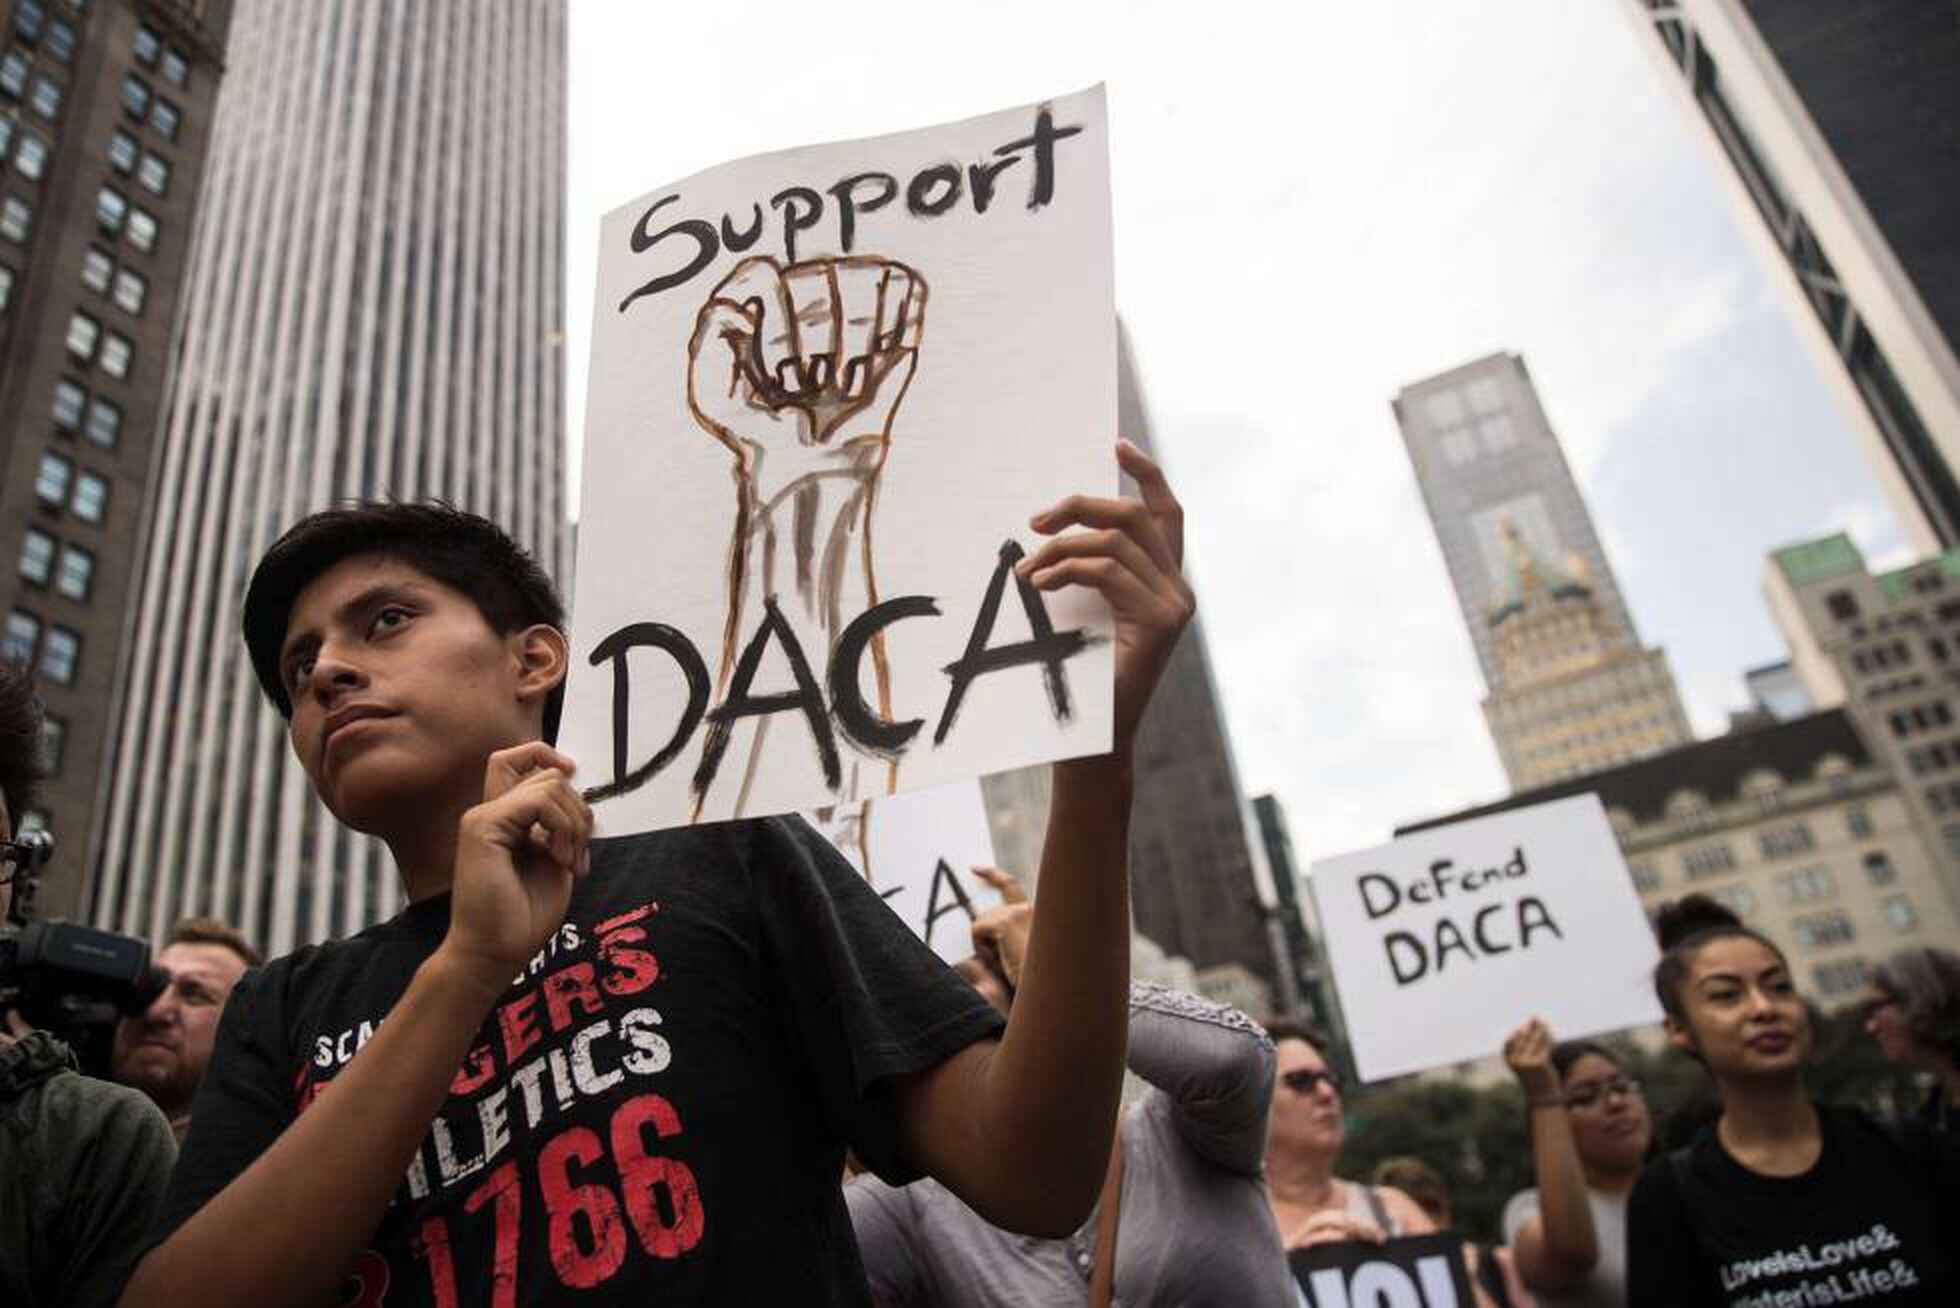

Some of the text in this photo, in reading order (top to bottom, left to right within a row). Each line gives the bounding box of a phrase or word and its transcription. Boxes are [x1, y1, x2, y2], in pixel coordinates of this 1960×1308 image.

[618, 101, 1083, 313] Support
[583, 538, 1104, 802] DACA
[1384, 897, 1563, 985] DACA
[410, 1095, 704, 1308] 1766
